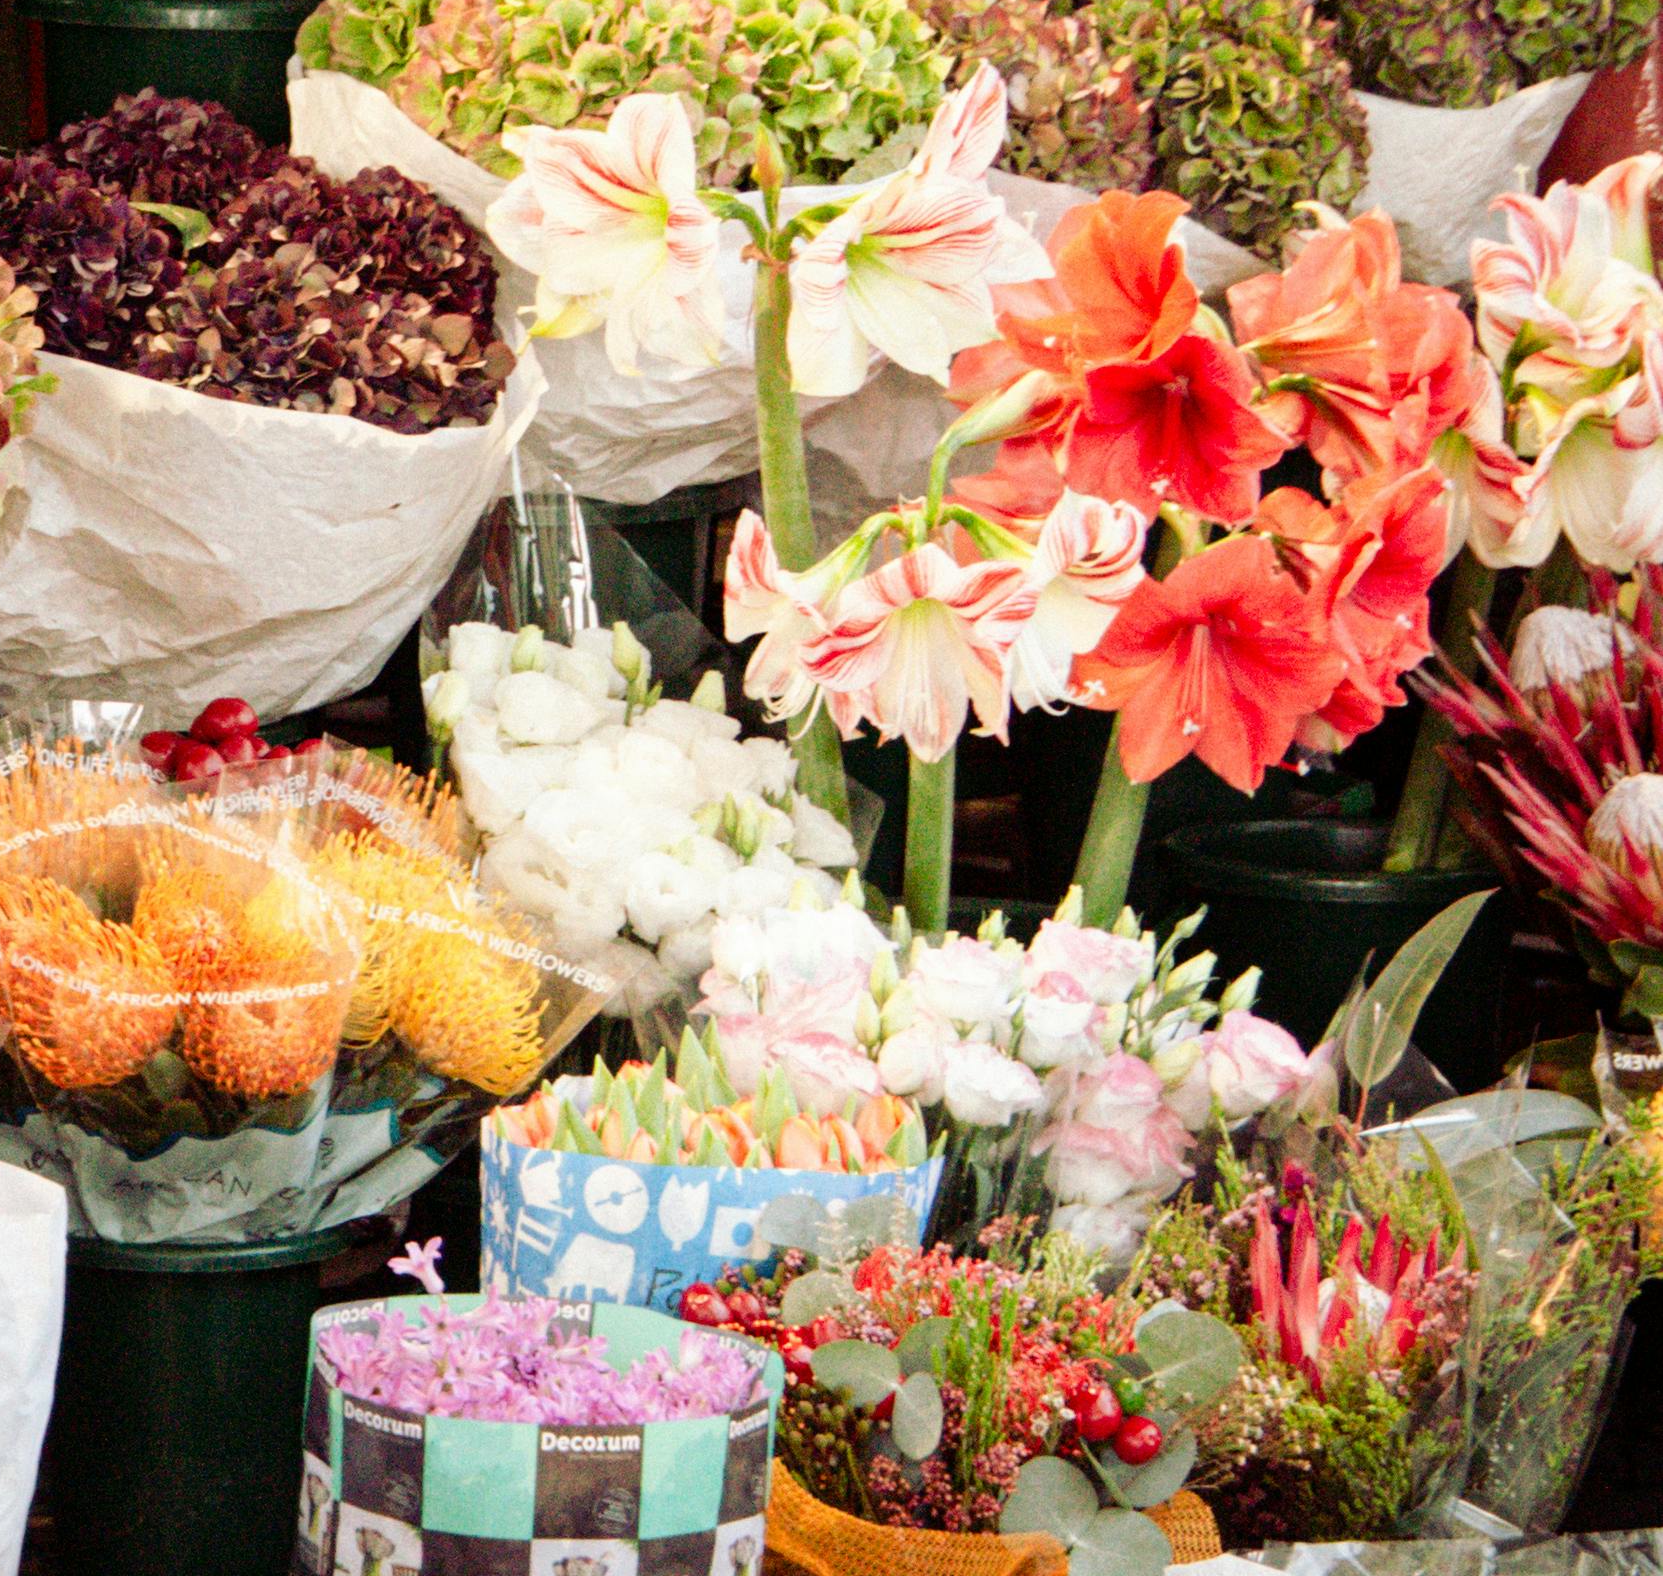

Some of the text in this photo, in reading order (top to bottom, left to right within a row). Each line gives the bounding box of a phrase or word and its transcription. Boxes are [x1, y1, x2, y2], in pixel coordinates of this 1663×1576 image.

[406, 910, 484, 946] AFRICAN
[10, 951, 65, 984] LONG
[105, 990, 192, 1007] AFRICAN
[196, 980, 330, 1006] WILDFLOWERS
[344, 1399, 423, 1439] Decorum
[541, 1430, 641, 1453] Decorum
